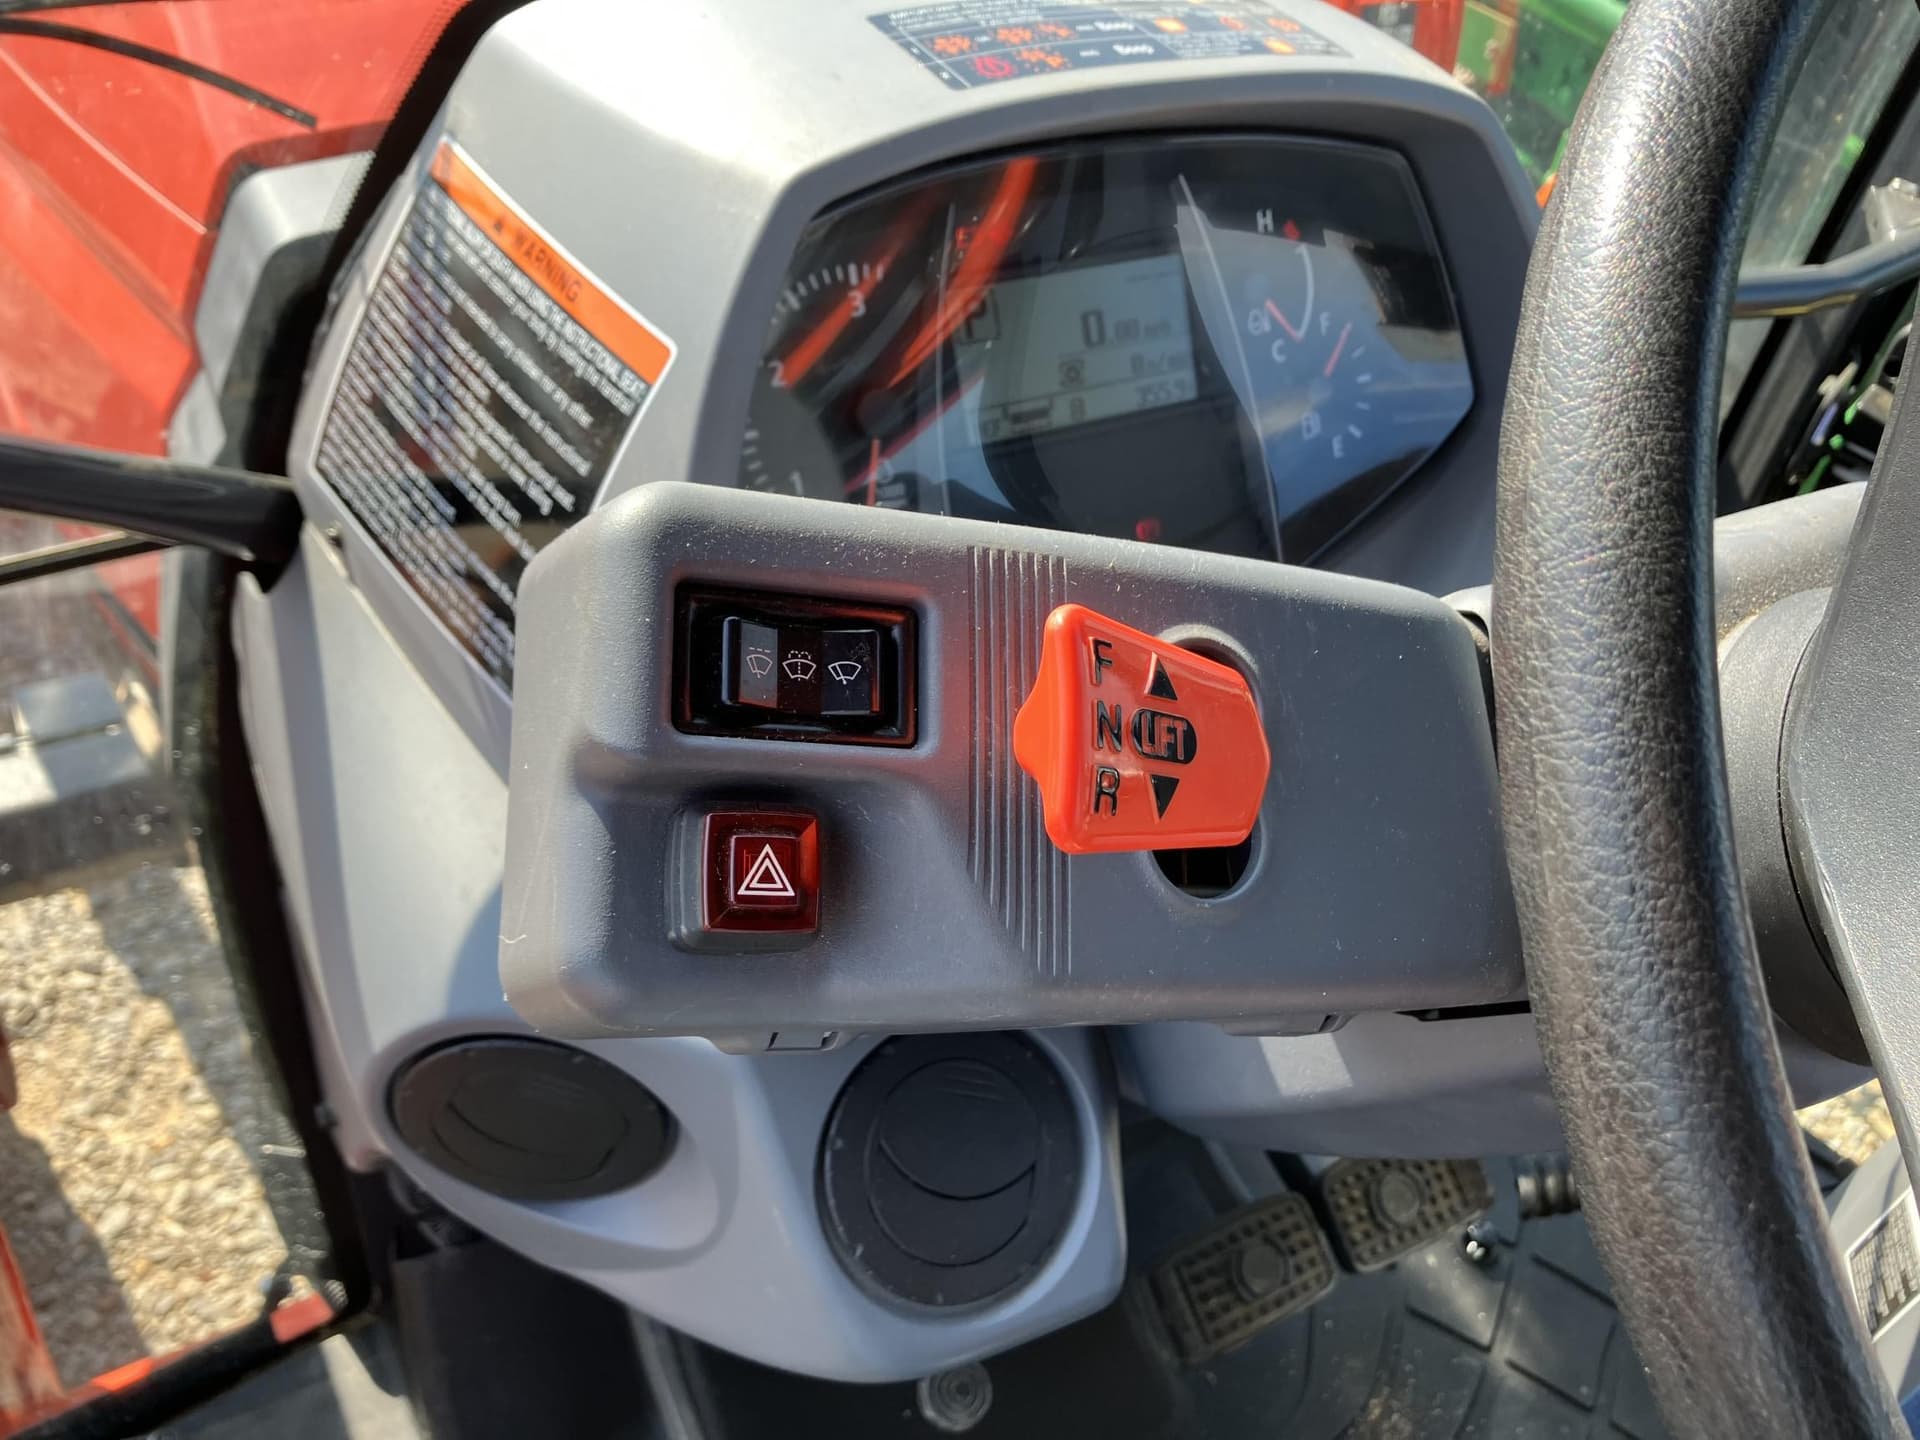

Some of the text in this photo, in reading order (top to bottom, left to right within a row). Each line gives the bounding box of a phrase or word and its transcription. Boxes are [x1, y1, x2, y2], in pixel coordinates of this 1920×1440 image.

[1256, 208, 1274, 233] H
[509, 230, 586, 302] WARNING
[849, 290, 866, 318] 3
[1320, 312, 1331, 336] F
[1272, 339, 1287, 363] C
[768, 361, 787, 388] 2
[1332, 435, 1344, 459] E
[1089, 636, 1113, 685] F
[1094, 700, 1188, 761] N LIFT
[1092, 765, 1121, 816] R
